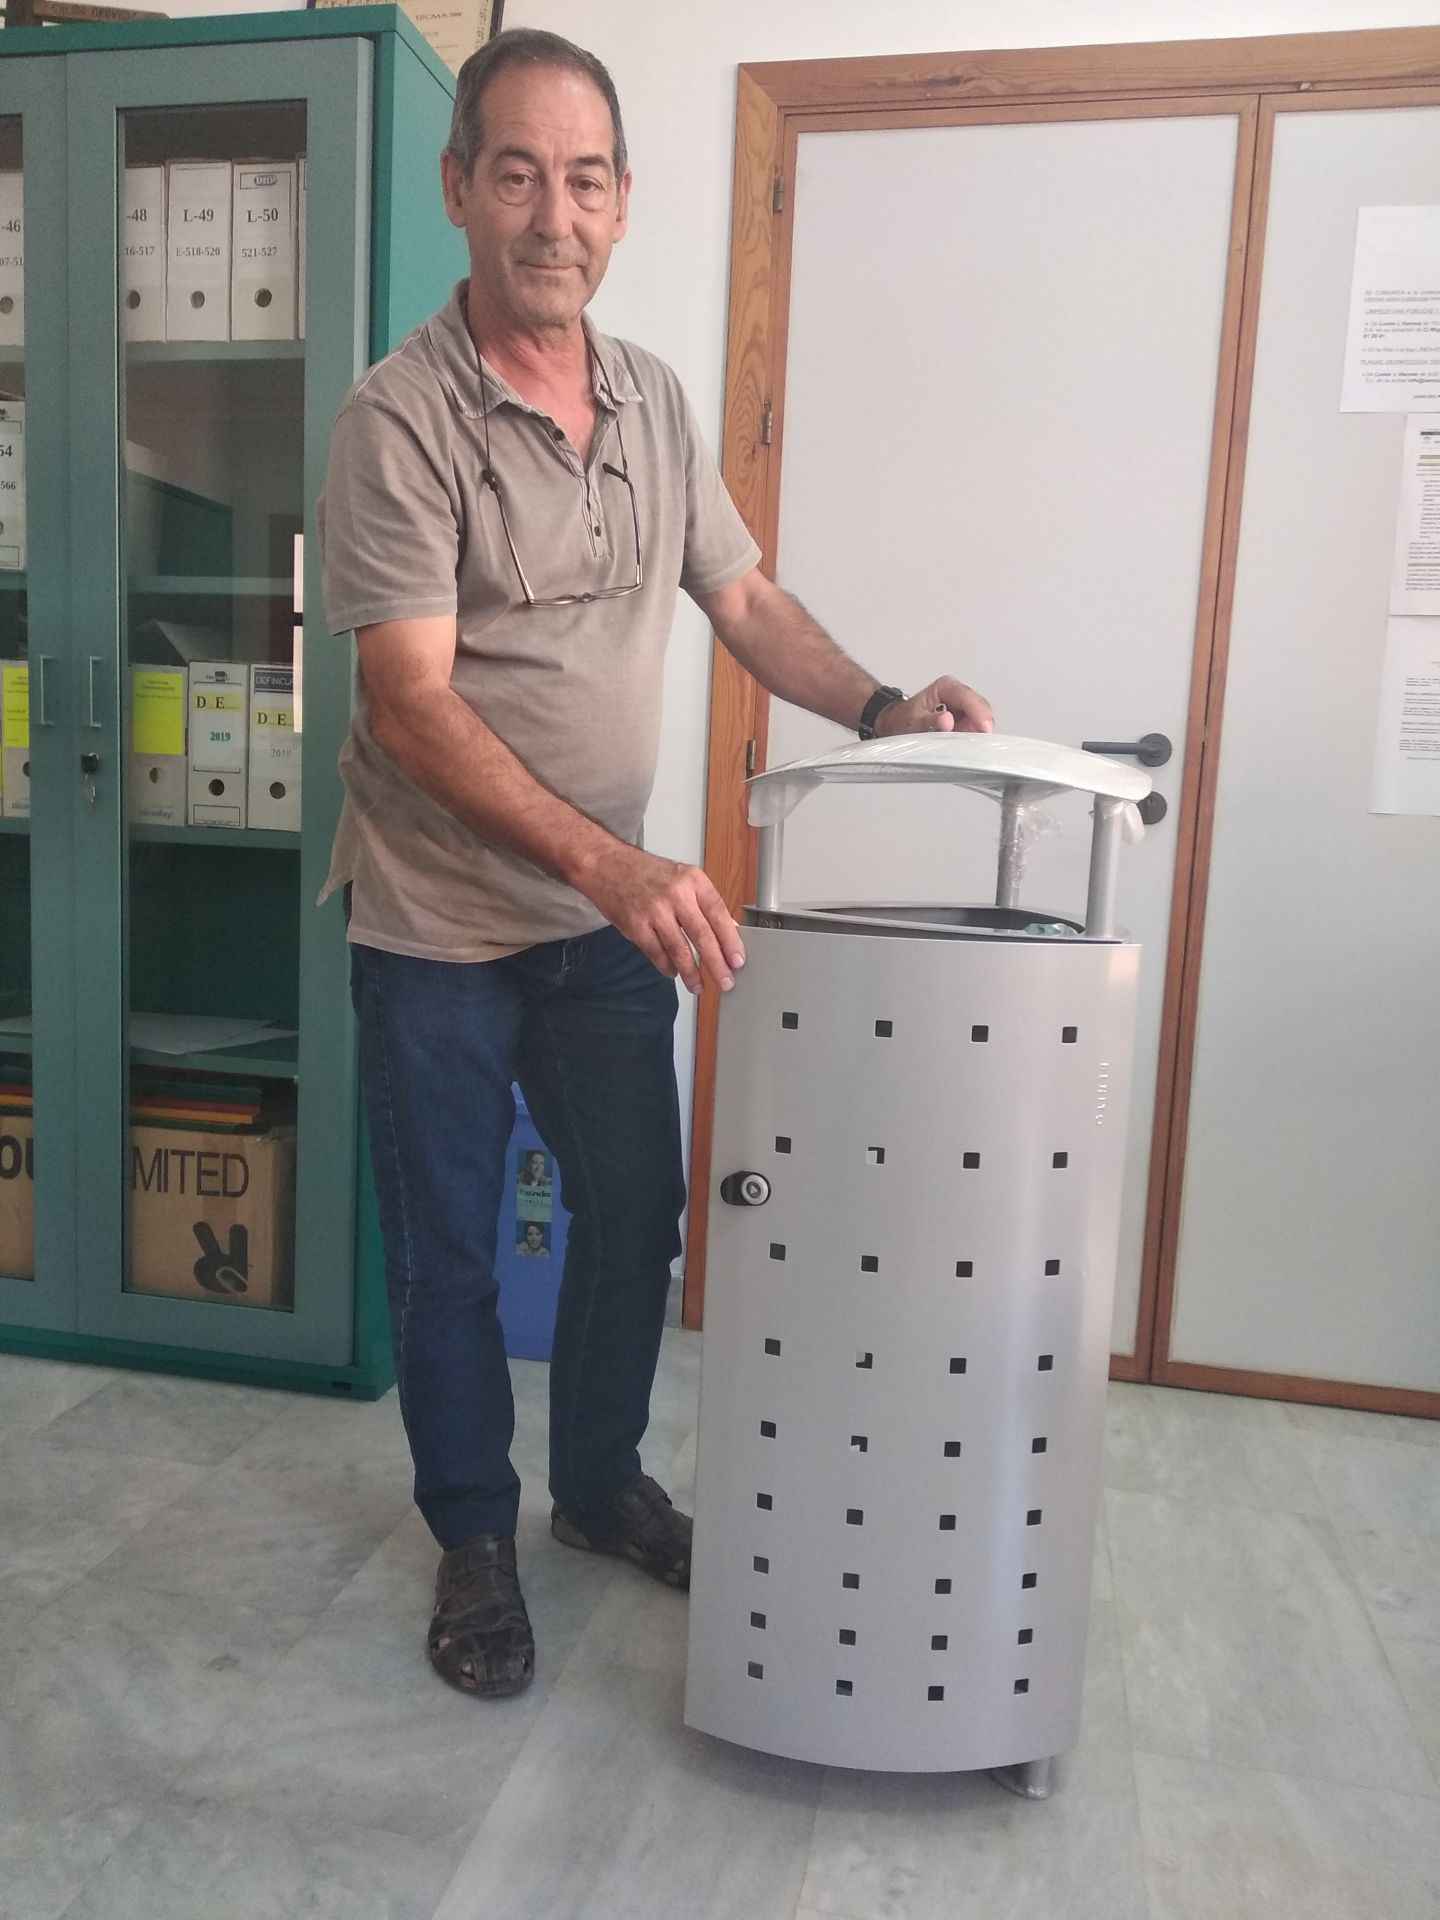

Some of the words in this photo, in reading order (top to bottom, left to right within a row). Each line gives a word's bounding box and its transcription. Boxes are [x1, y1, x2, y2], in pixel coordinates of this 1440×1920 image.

[183, 208, 215, 223] L-49
[247, 207, 280, 223] L-50
[176, 246, 221, 257] E-518-520
[241, 246, 278, 258] 521-527
[209, 731, 231, 742] 2019
[132, 1146, 250, 1199] MITED
